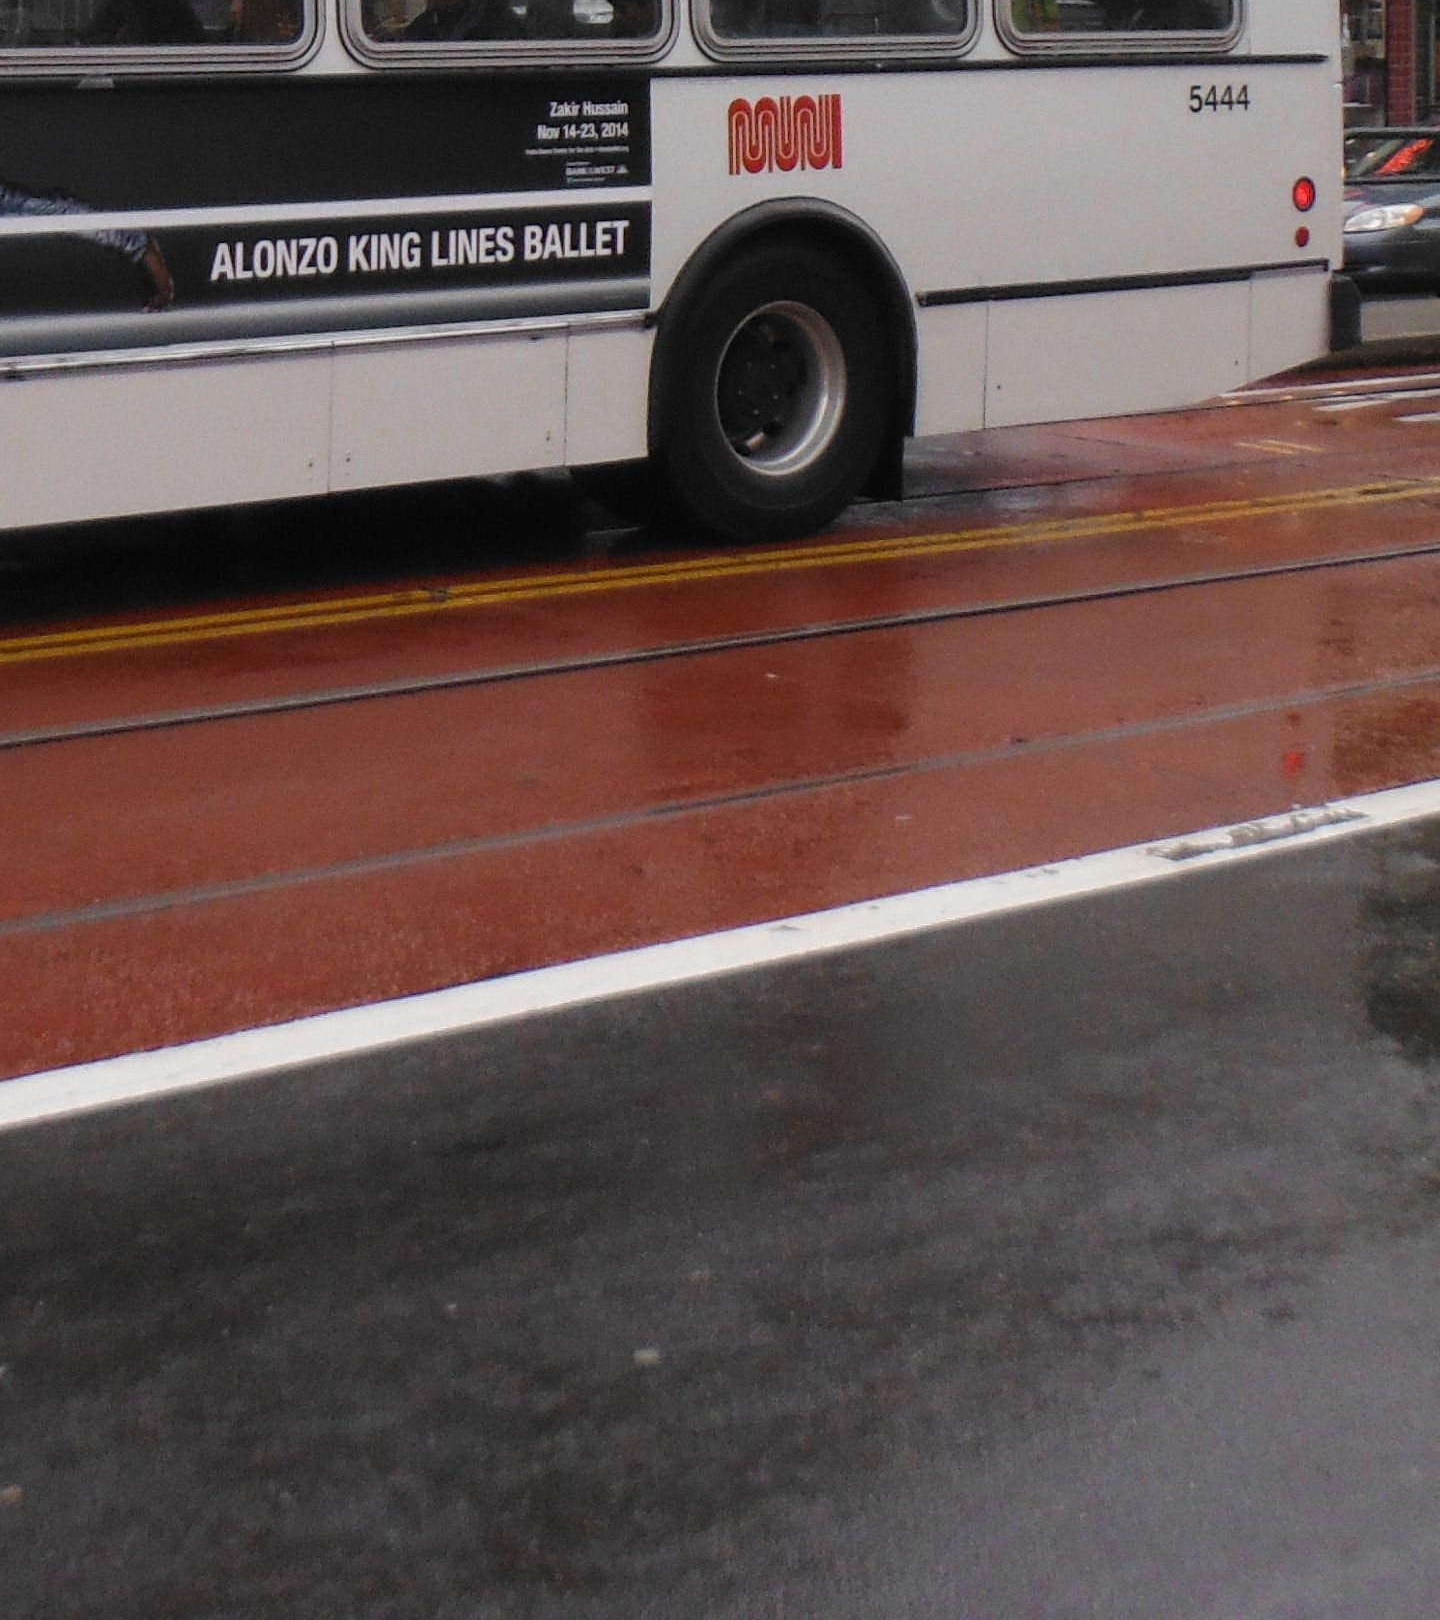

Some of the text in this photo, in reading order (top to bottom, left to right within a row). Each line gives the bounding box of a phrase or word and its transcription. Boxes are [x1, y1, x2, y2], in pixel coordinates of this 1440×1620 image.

[549, 99, 629, 118] Zakir Hussain
[1188, 84, 1251, 114] 5444
[537, 121, 629, 140] Nov 14-23, 2014
[210, 220, 631, 281] ALONZO KING LINES BALLET
